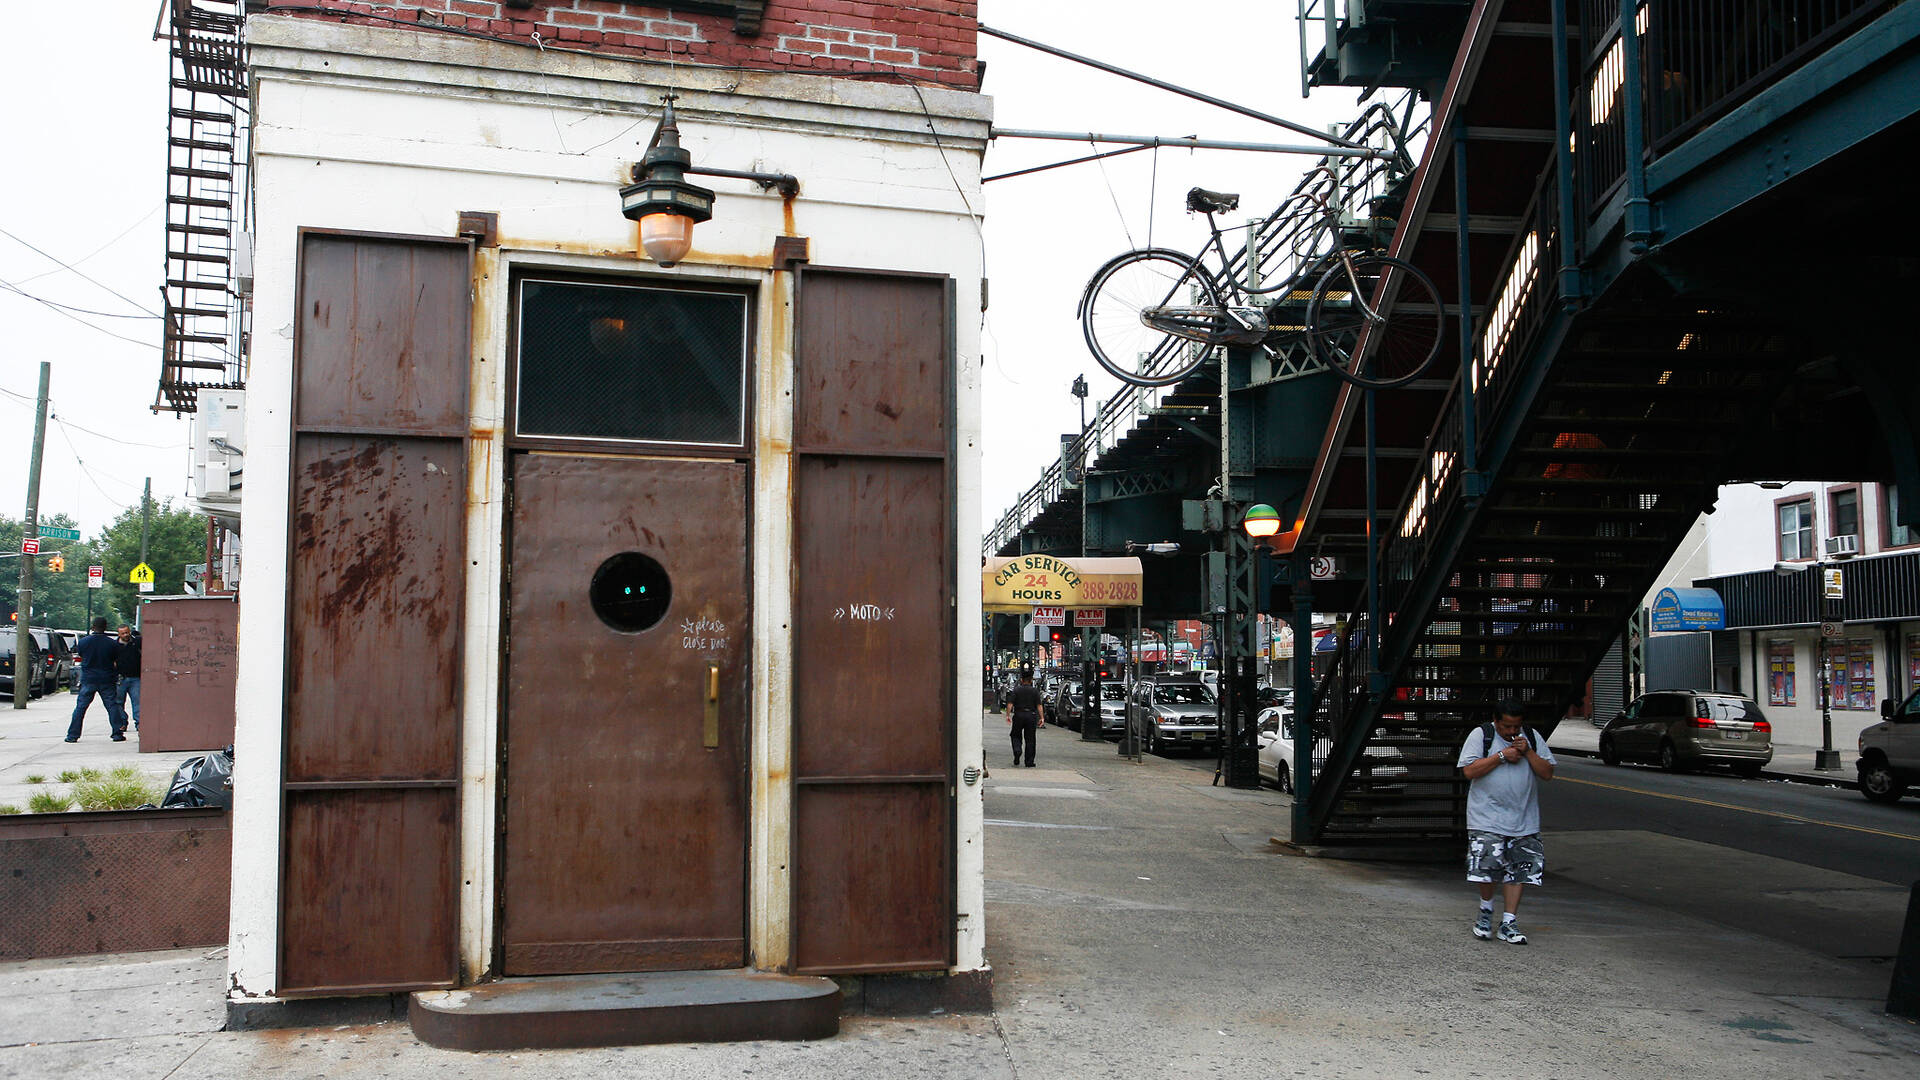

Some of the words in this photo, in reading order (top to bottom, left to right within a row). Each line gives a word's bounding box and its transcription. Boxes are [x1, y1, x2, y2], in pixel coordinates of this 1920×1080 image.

[38, 527, 72, 538] HARRISON
[994, 563, 1021, 587] CAR
[1025, 556, 1082, 589] SERVICE
[1024, 574, 1048, 587] 24
[1012, 590, 1062, 600] HOURS
[1083, 582, 1138, 600] 388-2828
[850, 603, 881, 620] MOTO
[1035, 608, 1062, 617] ATM
[1077, 609, 1103, 618] ATM
[683, 636, 706, 650] CLOSE
